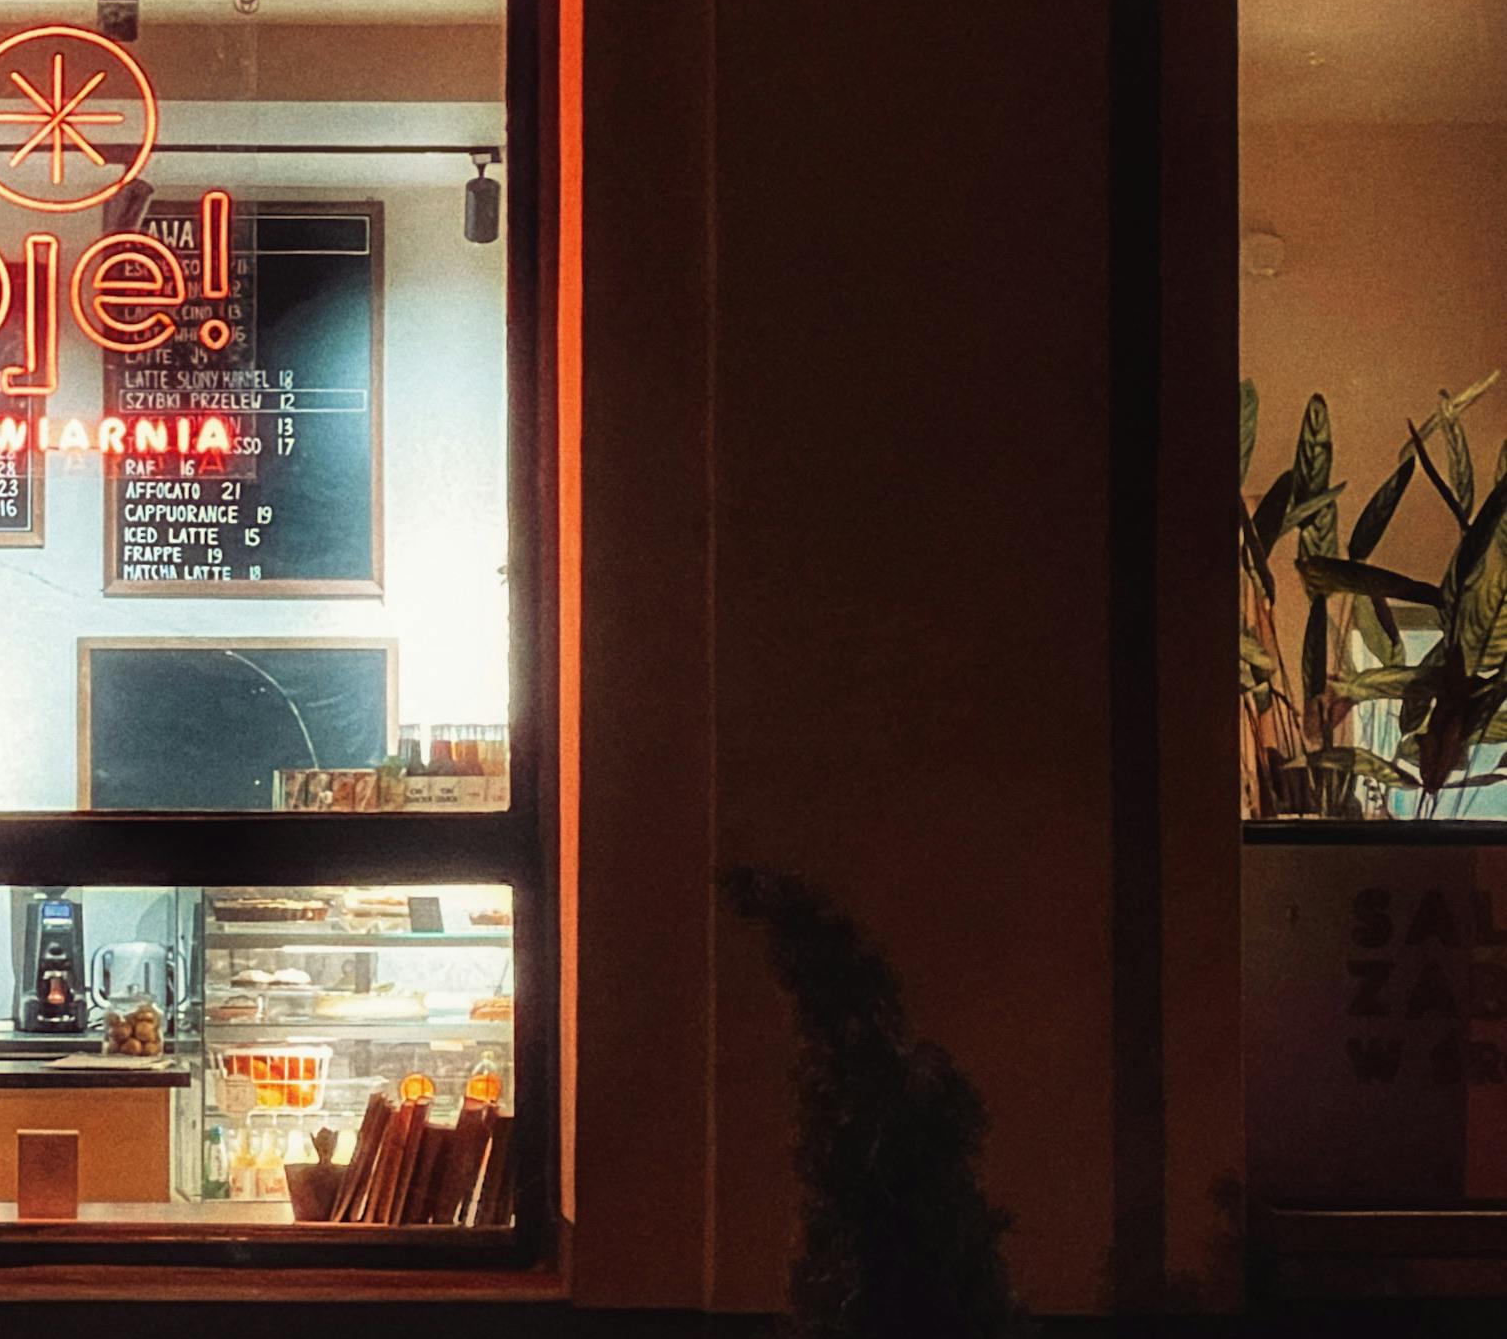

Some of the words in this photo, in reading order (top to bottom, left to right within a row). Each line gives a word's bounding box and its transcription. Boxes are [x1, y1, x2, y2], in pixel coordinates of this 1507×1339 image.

[145, 220, 194, 249] AWA
[124, 370, 168, 389] LATTE
[279, 370, 294, 390] 18
[125, 392, 181, 409] SZYBKI
[190, 392, 262, 409] PRZELEW
[279, 393, 296, 410] 12
[277, 417, 294, 436] 13
[277, 438, 296, 456] 17
[125, 459, 156, 476] RAF
[180, 459, 196, 476] 16
[221, 481, 241, 501] 21
[0, 499, 18, 517] 16
[256, 506, 273, 524] 19
[124, 527, 158, 544] ICED
[168, 527, 219, 545] LATTE
[244, 528, 261, 547] 15
[123, 546, 182, 562] FRAPPE
[207, 547, 223, 564] 19
[123, 564, 178, 580] MATCHA
[184, 565, 232, 581] LATTE
